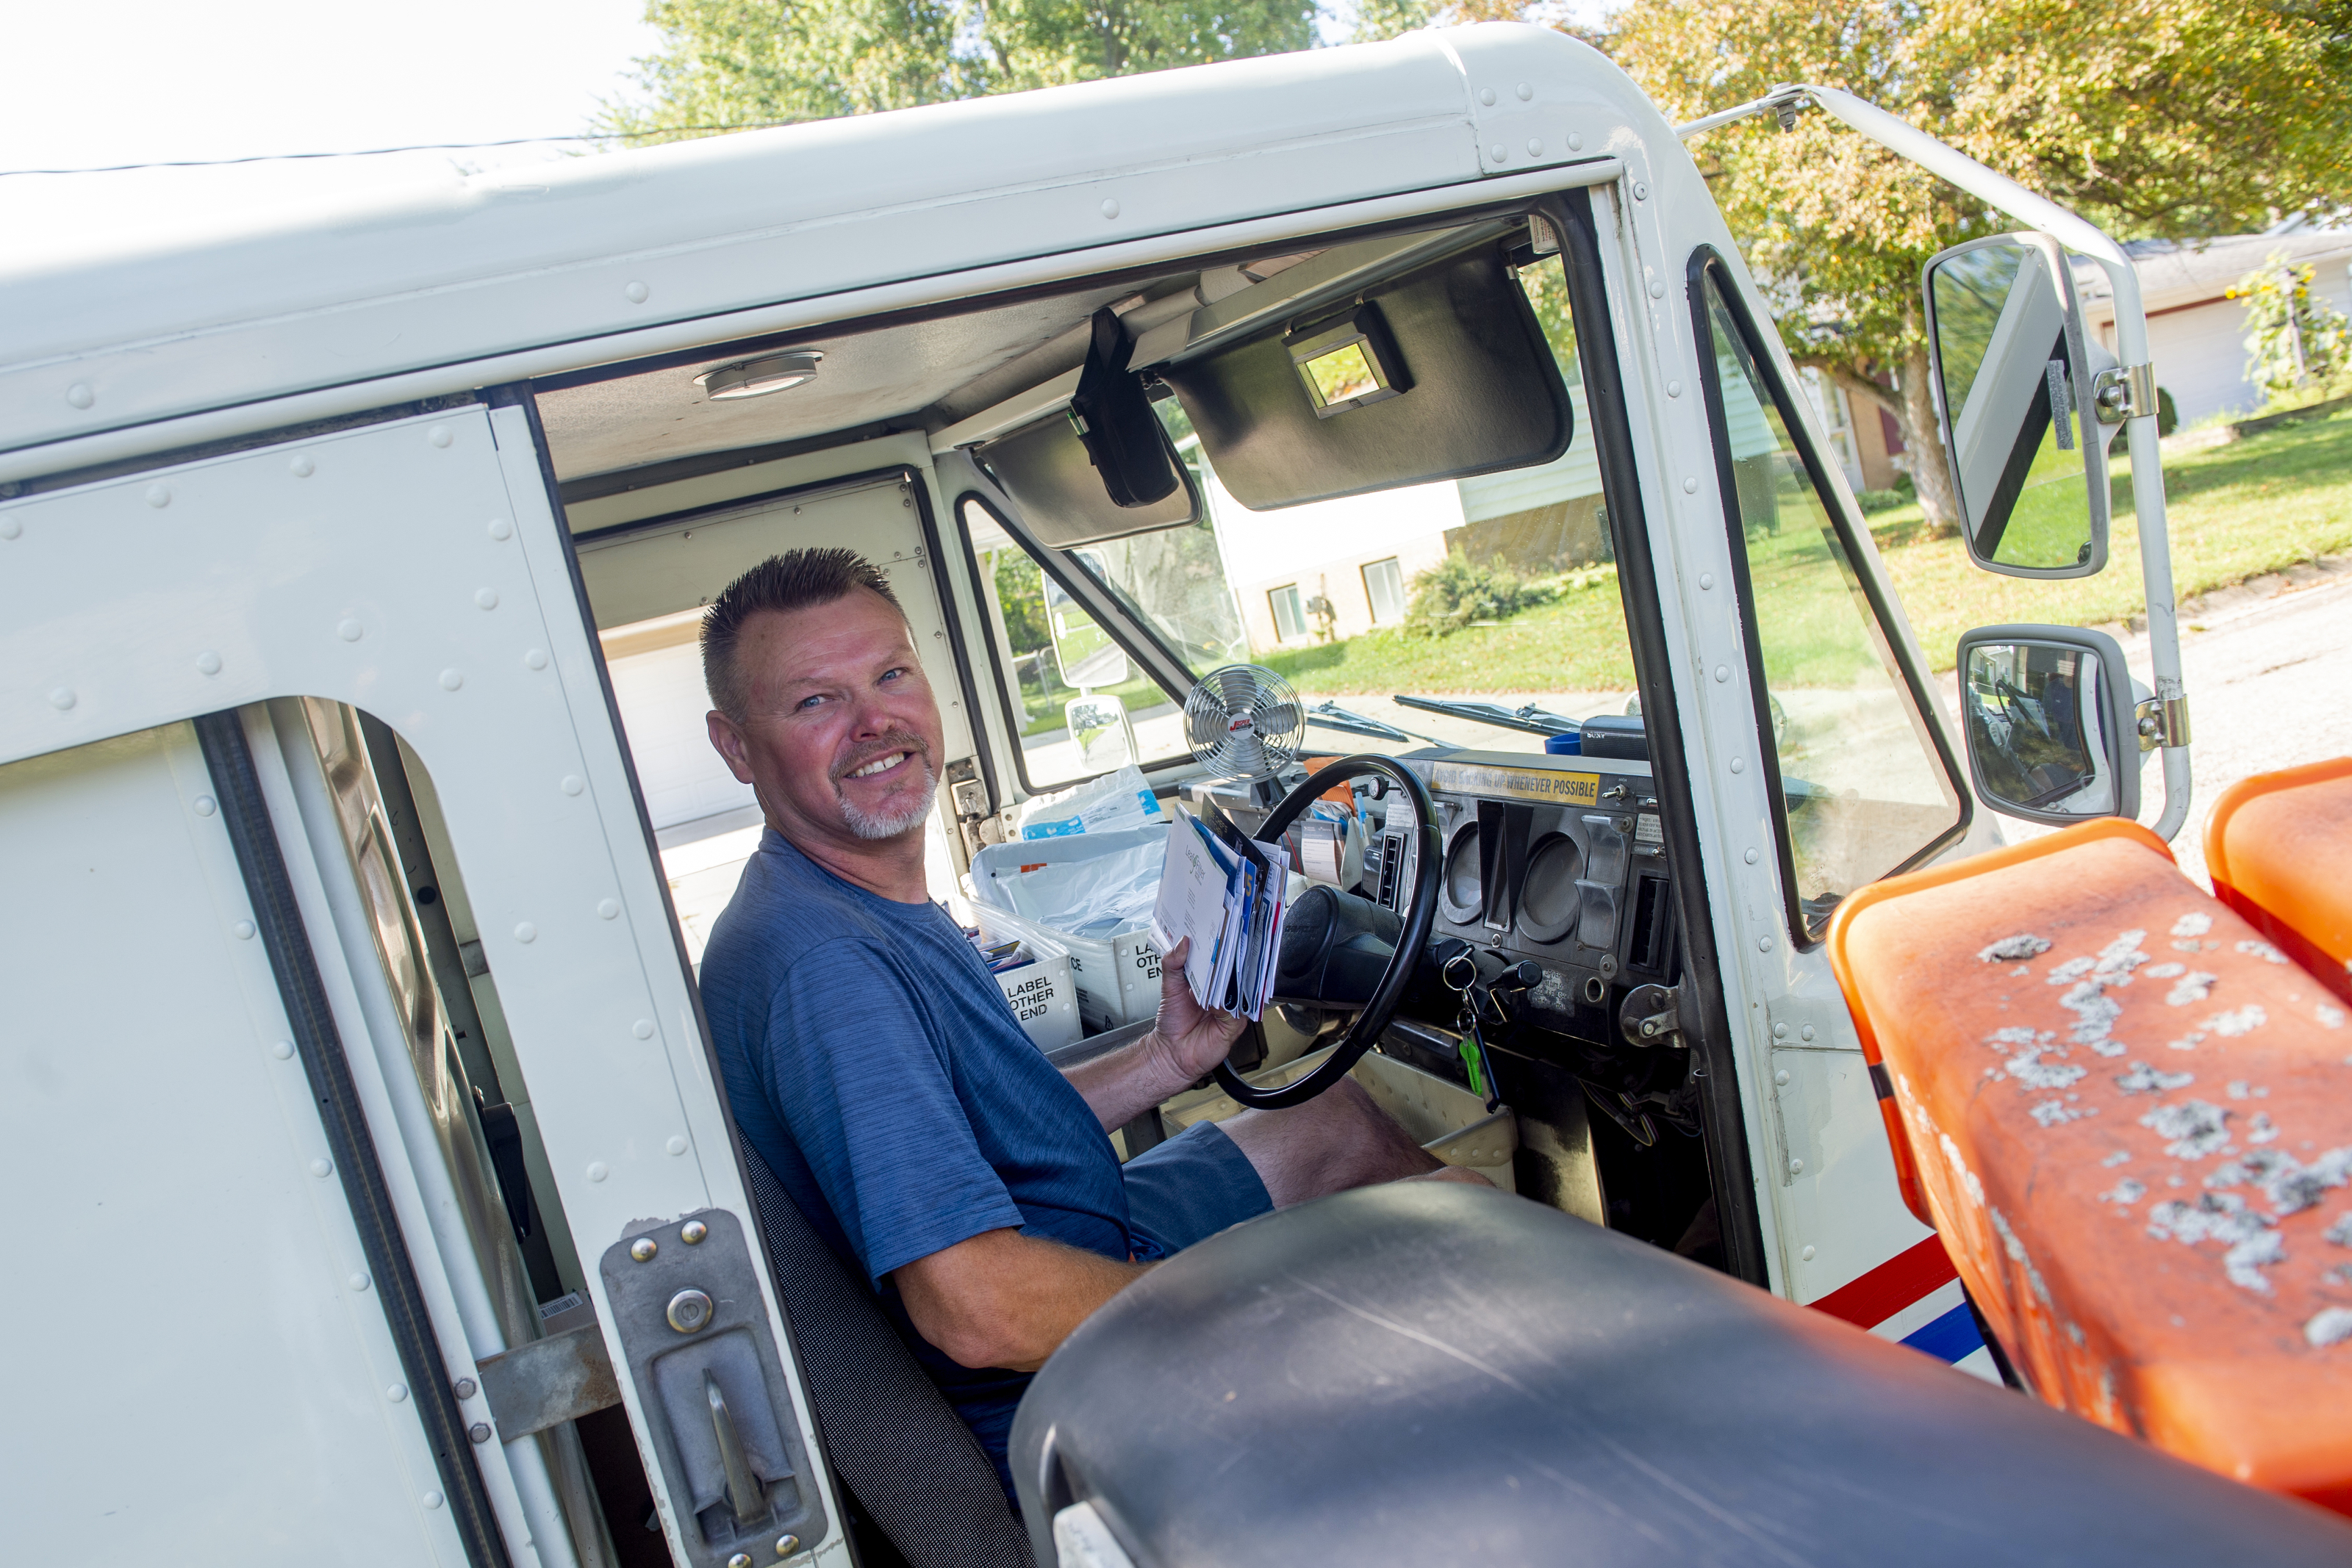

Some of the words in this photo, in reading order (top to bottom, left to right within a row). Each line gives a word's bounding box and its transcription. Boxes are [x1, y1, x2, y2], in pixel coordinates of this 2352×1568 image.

[1434, 769, 1457, 784] AVOID
[1458, 772, 1493, 788] BACKING
[1494, 774, 1506, 789] UP
[1507, 774, 1551, 794] WHENEVER
[1552, 779, 1596, 798] POSSIBLE
[1007, 976, 1053, 999] LABEL
[1009, 988, 1055, 1011] OTHER
[1021, 1004, 1048, 1022] END
